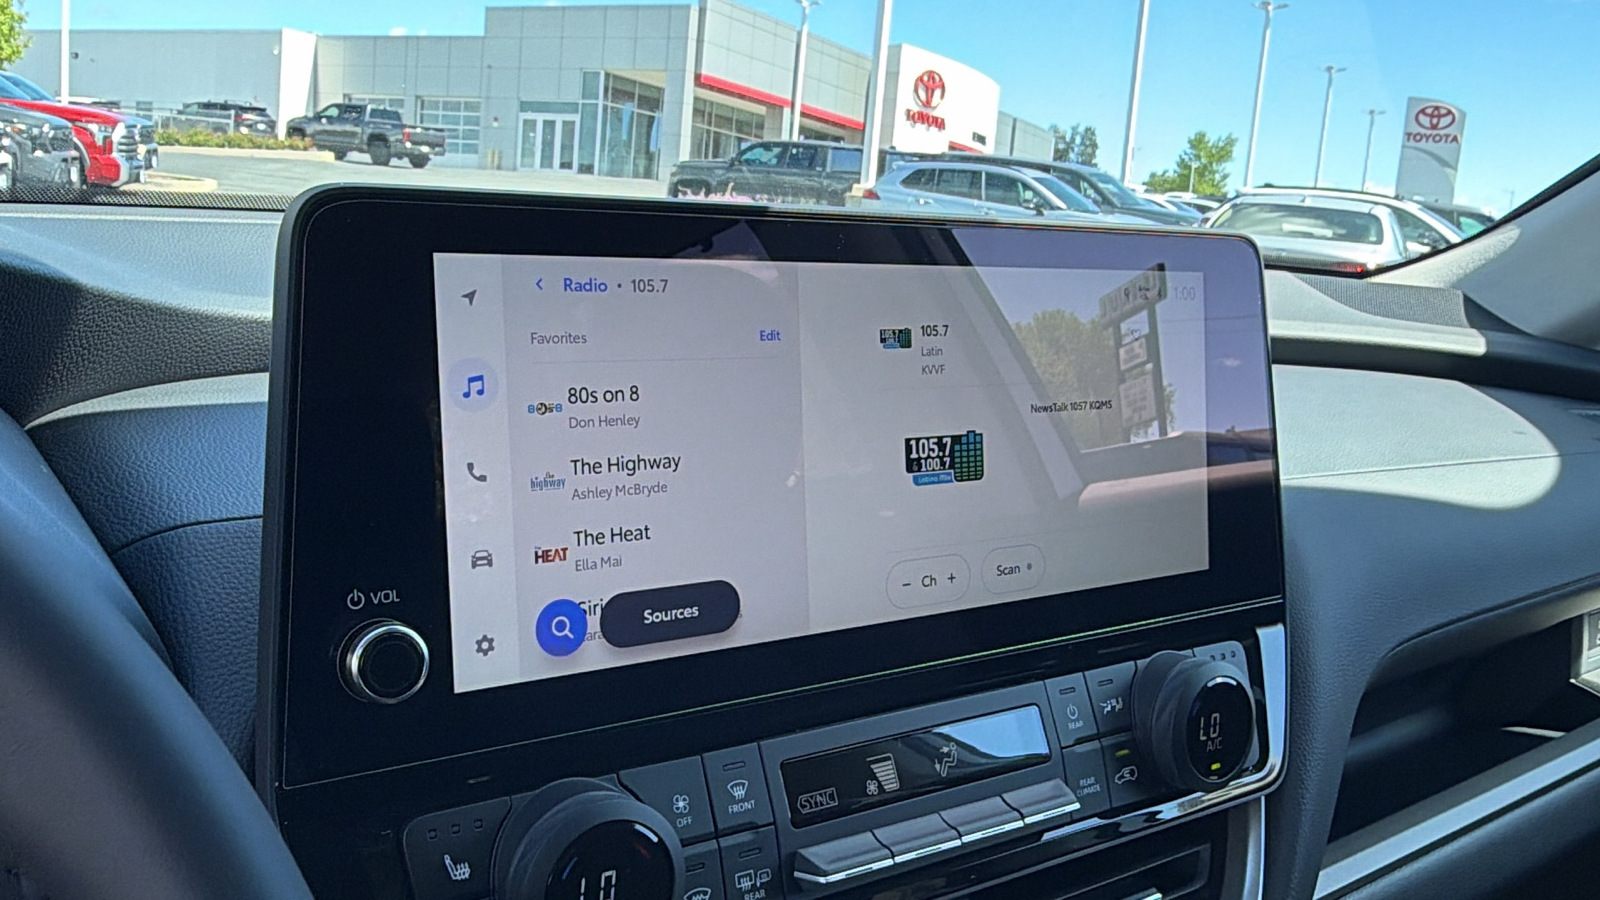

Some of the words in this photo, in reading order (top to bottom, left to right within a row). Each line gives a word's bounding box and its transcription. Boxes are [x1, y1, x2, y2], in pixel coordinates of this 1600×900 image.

[906, 108, 946, 131] TOYOTA
[1405, 132, 1459, 144] TOYOTA
[563, 278, 608, 293] Radio
[630, 279, 669, 293] 105.7
[530, 331, 587, 345] Favorites
[759, 330, 781, 342] Edit
[920, 325, 949, 337] 105.7
[921, 346, 943, 356] Latin
[921, 364, 946, 375] KVVF
[567, 387, 598, 404] 80s
[602, 390, 623, 403] on
[629, 386, 640, 401] 8
[1030, 402, 1069, 413] NewsTalk
[1069, 402, 1088, 412] 1057
[1088, 400, 1113, 411] KQMS
[569, 416, 595, 429] Don
[598, 414, 641, 429] Henley
[909, 437, 952, 459] 105.7
[570, 459, 603, 476] The
[607, 455, 681, 476] Highway
[920, 457, 951, 471] 100.7
[530, 477, 566, 491] highway
[571, 486, 613, 501] Ashley
[615, 481, 668, 497] McBryde
[573, 530, 605, 547] The
[610, 525, 651, 543] Heat
[534, 547, 568, 564] HEAT
[575, 559, 598, 572] Ella
[600, 556, 623, 569] Mai
[996, 564, 1021, 576] Scan
[921, 575, 937, 587] Ch
[370, 589, 400, 604] VOL
[643, 605, 699, 624] Sources
[1067, 721, 1084, 730] REAR
[1206, 737, 1222, 752] A/C
[1079, 777, 1096, 788] REAR
[1076, 783, 1101, 798] CLIMATE
[728, 799, 756, 814] FRONT
[800, 789, 836, 811] SYNC
[676, 816, 693, 828] OFF
[744, 889, 766, 900] REAR
